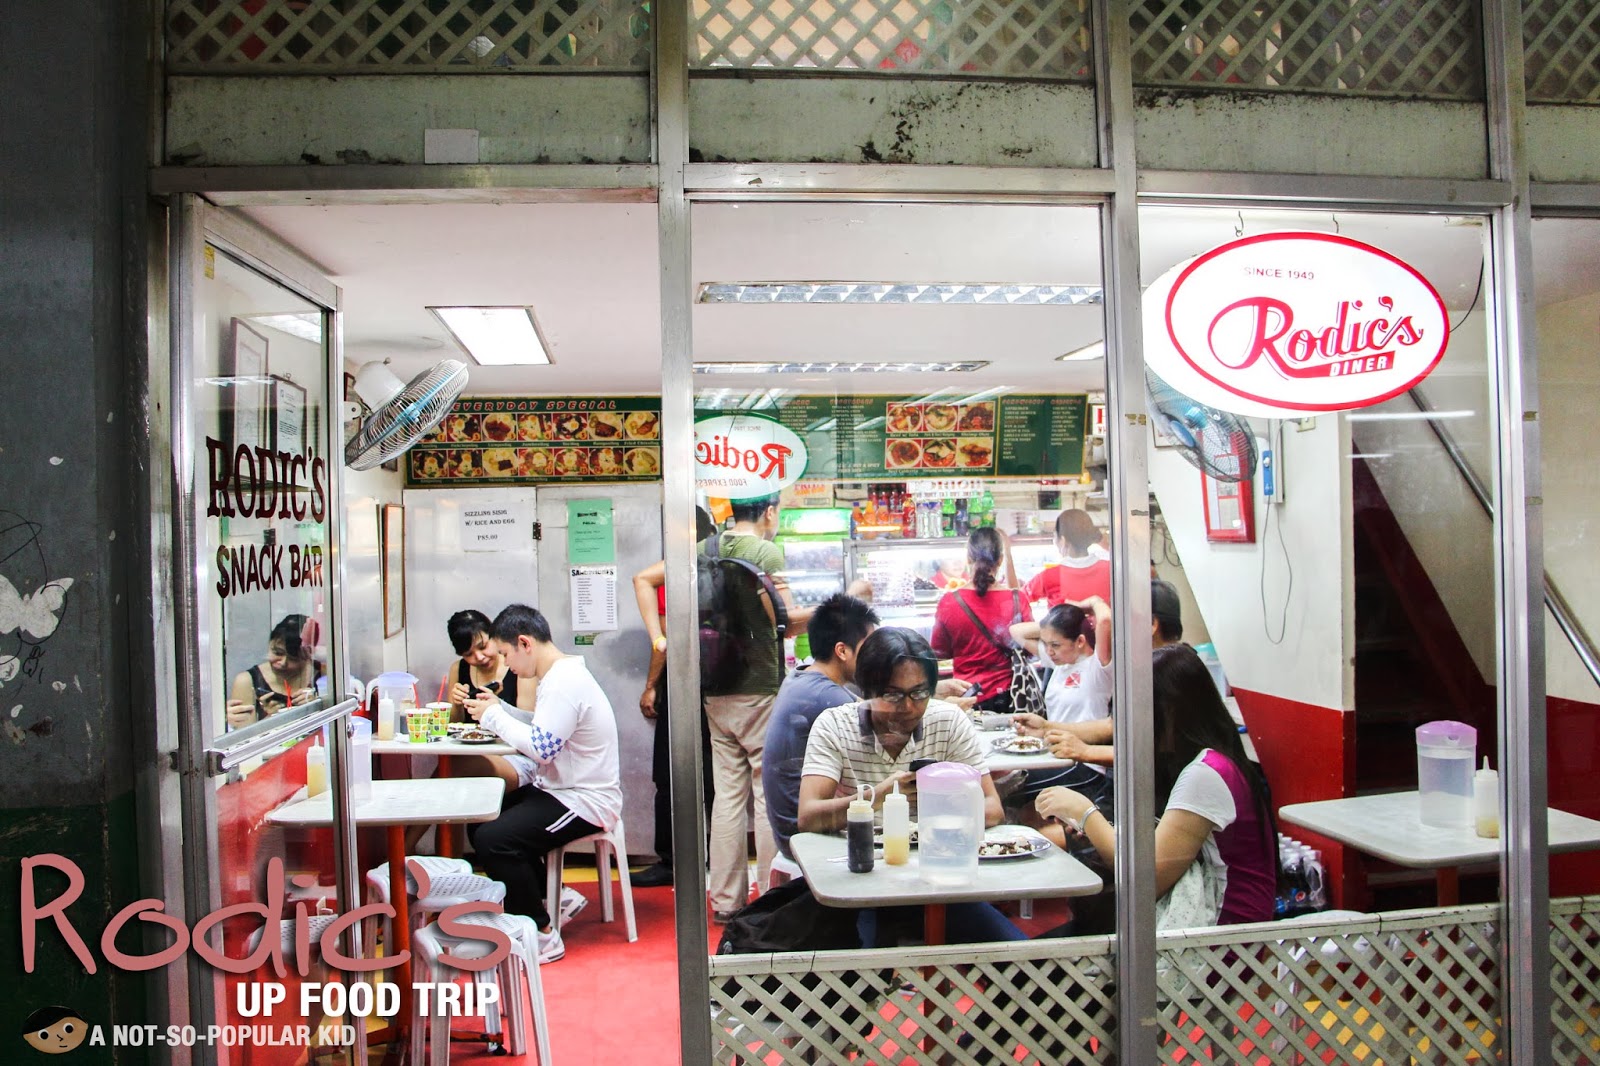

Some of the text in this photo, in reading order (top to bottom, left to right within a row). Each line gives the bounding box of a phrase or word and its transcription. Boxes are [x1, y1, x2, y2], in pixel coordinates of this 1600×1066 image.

[1243, 267, 1283, 279] SINCE
[1207, 296, 1424, 380] Rodic's
[1329, 355, 1388, 377] DINER
[453, 400, 617, 411] EVERYDAY SPECIAL
[206, 435, 326, 524] RODIC'S
[216, 543, 323, 598] SNACK BAR
